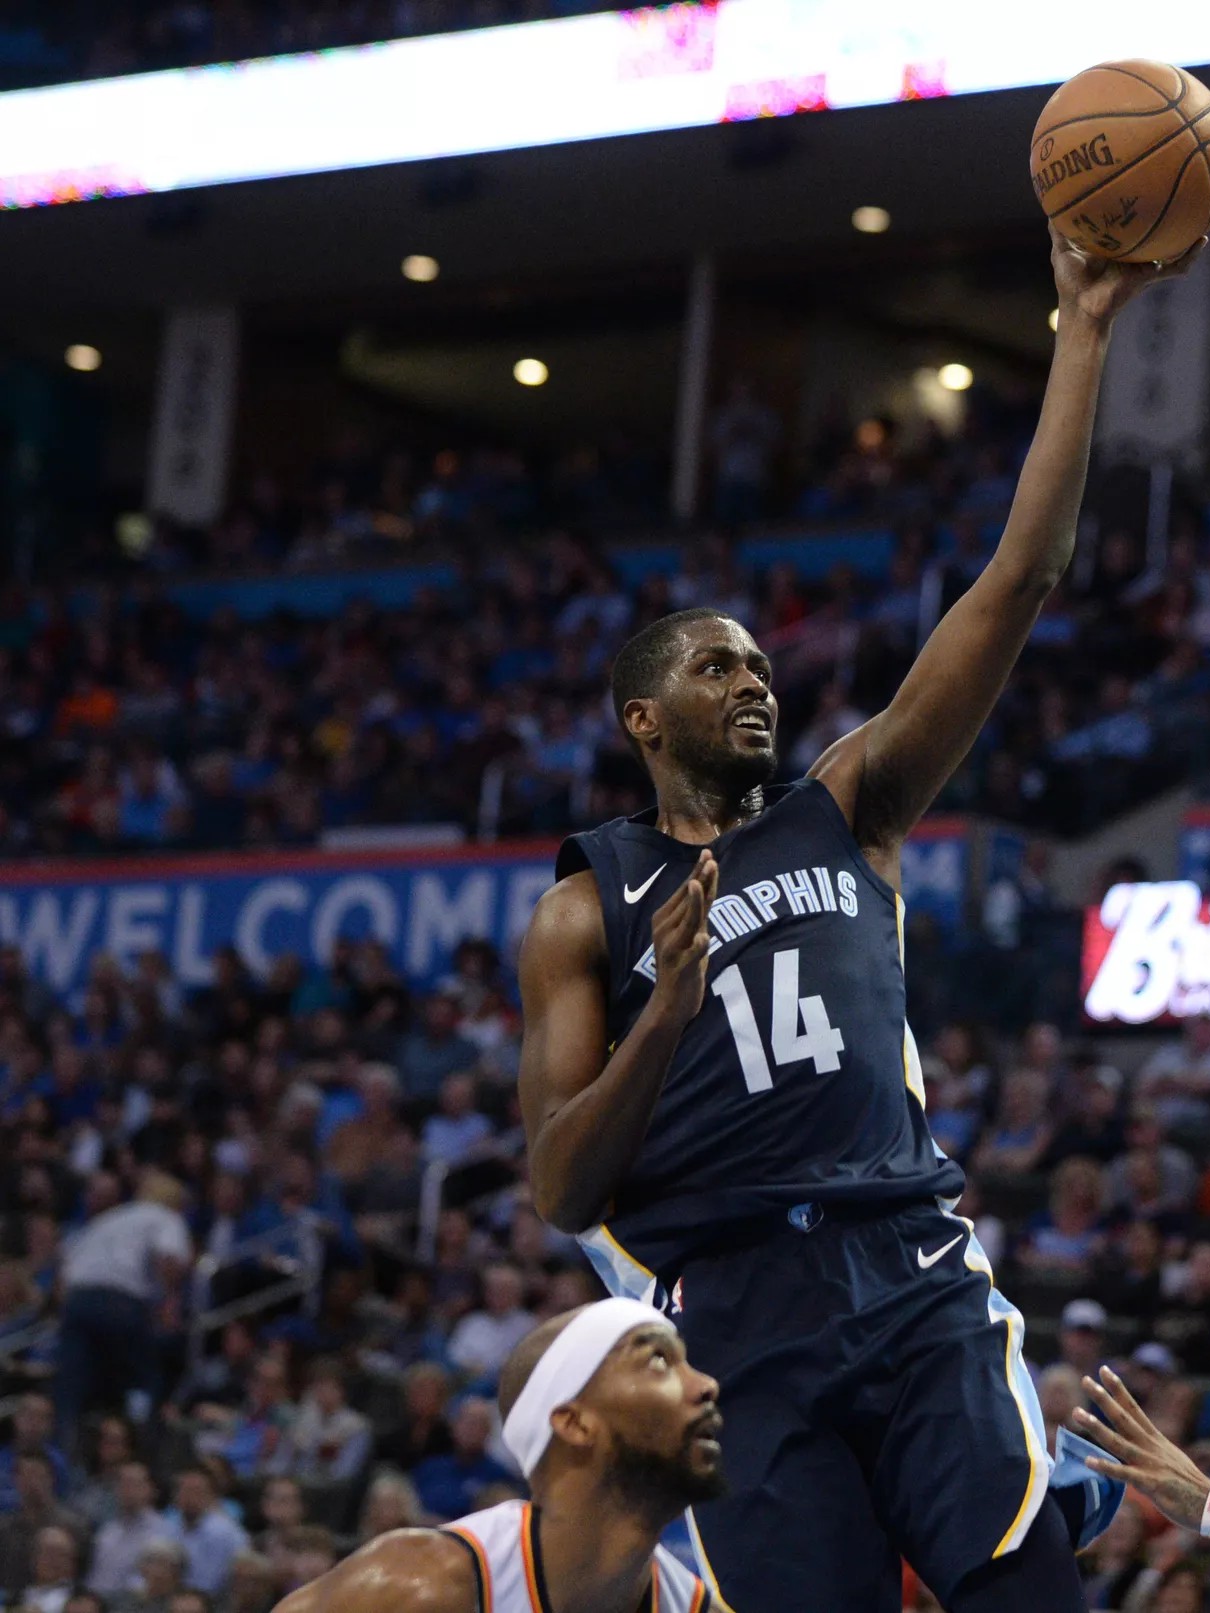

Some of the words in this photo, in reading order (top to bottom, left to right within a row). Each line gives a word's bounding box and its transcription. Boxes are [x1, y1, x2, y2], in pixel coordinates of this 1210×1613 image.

[1033, 133, 1114, 197] ALDING
[633, 867, 858, 983] MPHIS
[711, 948, 844, 1094] 14
